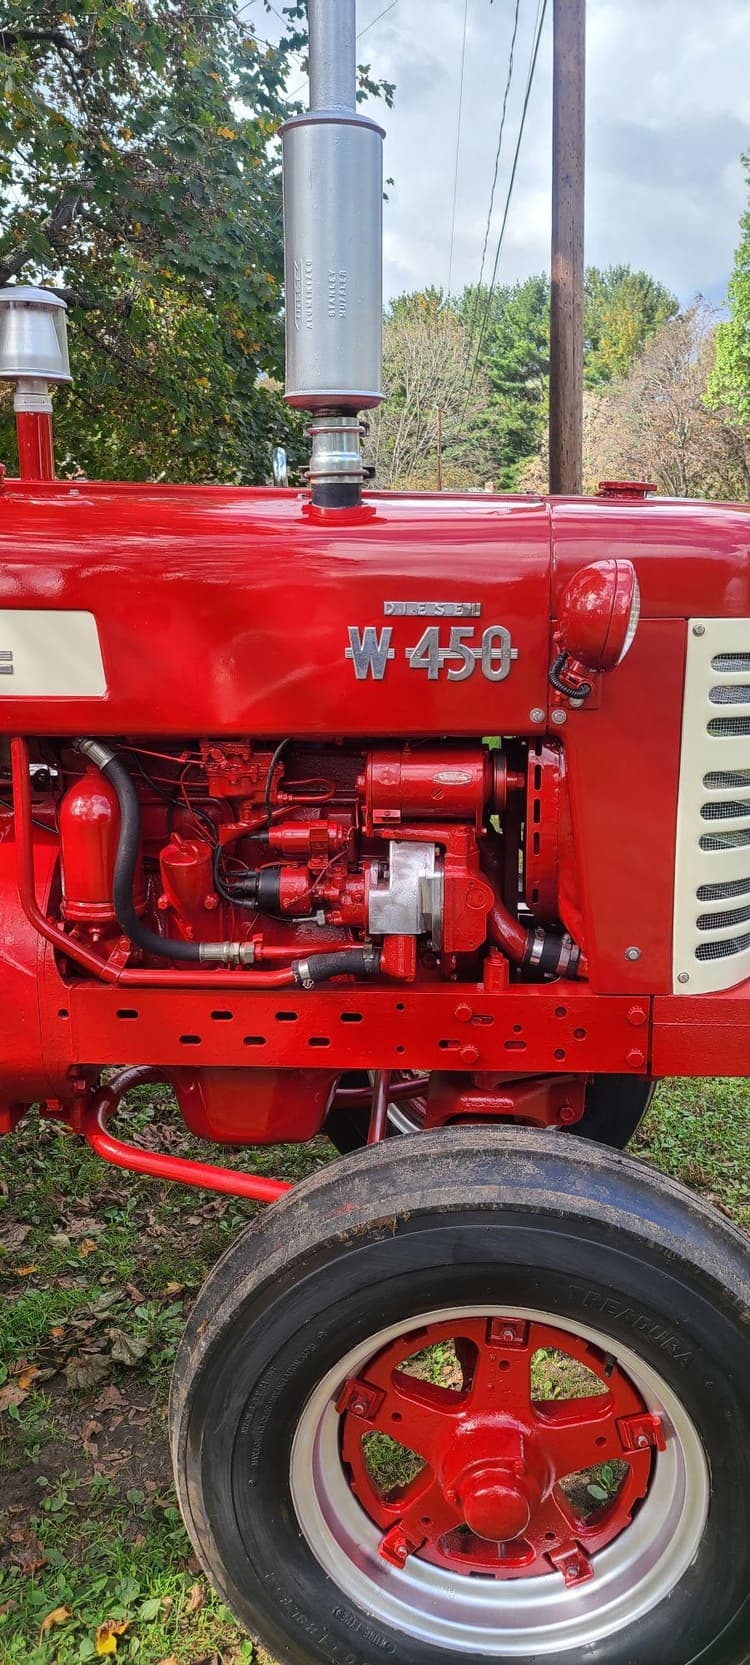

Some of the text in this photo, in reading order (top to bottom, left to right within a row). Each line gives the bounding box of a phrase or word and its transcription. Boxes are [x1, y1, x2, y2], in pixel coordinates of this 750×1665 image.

[328, 270, 336, 318] STANLEY
[385, 602, 481, 616] DIESEL
[347, 625, 512, 682] W 450
